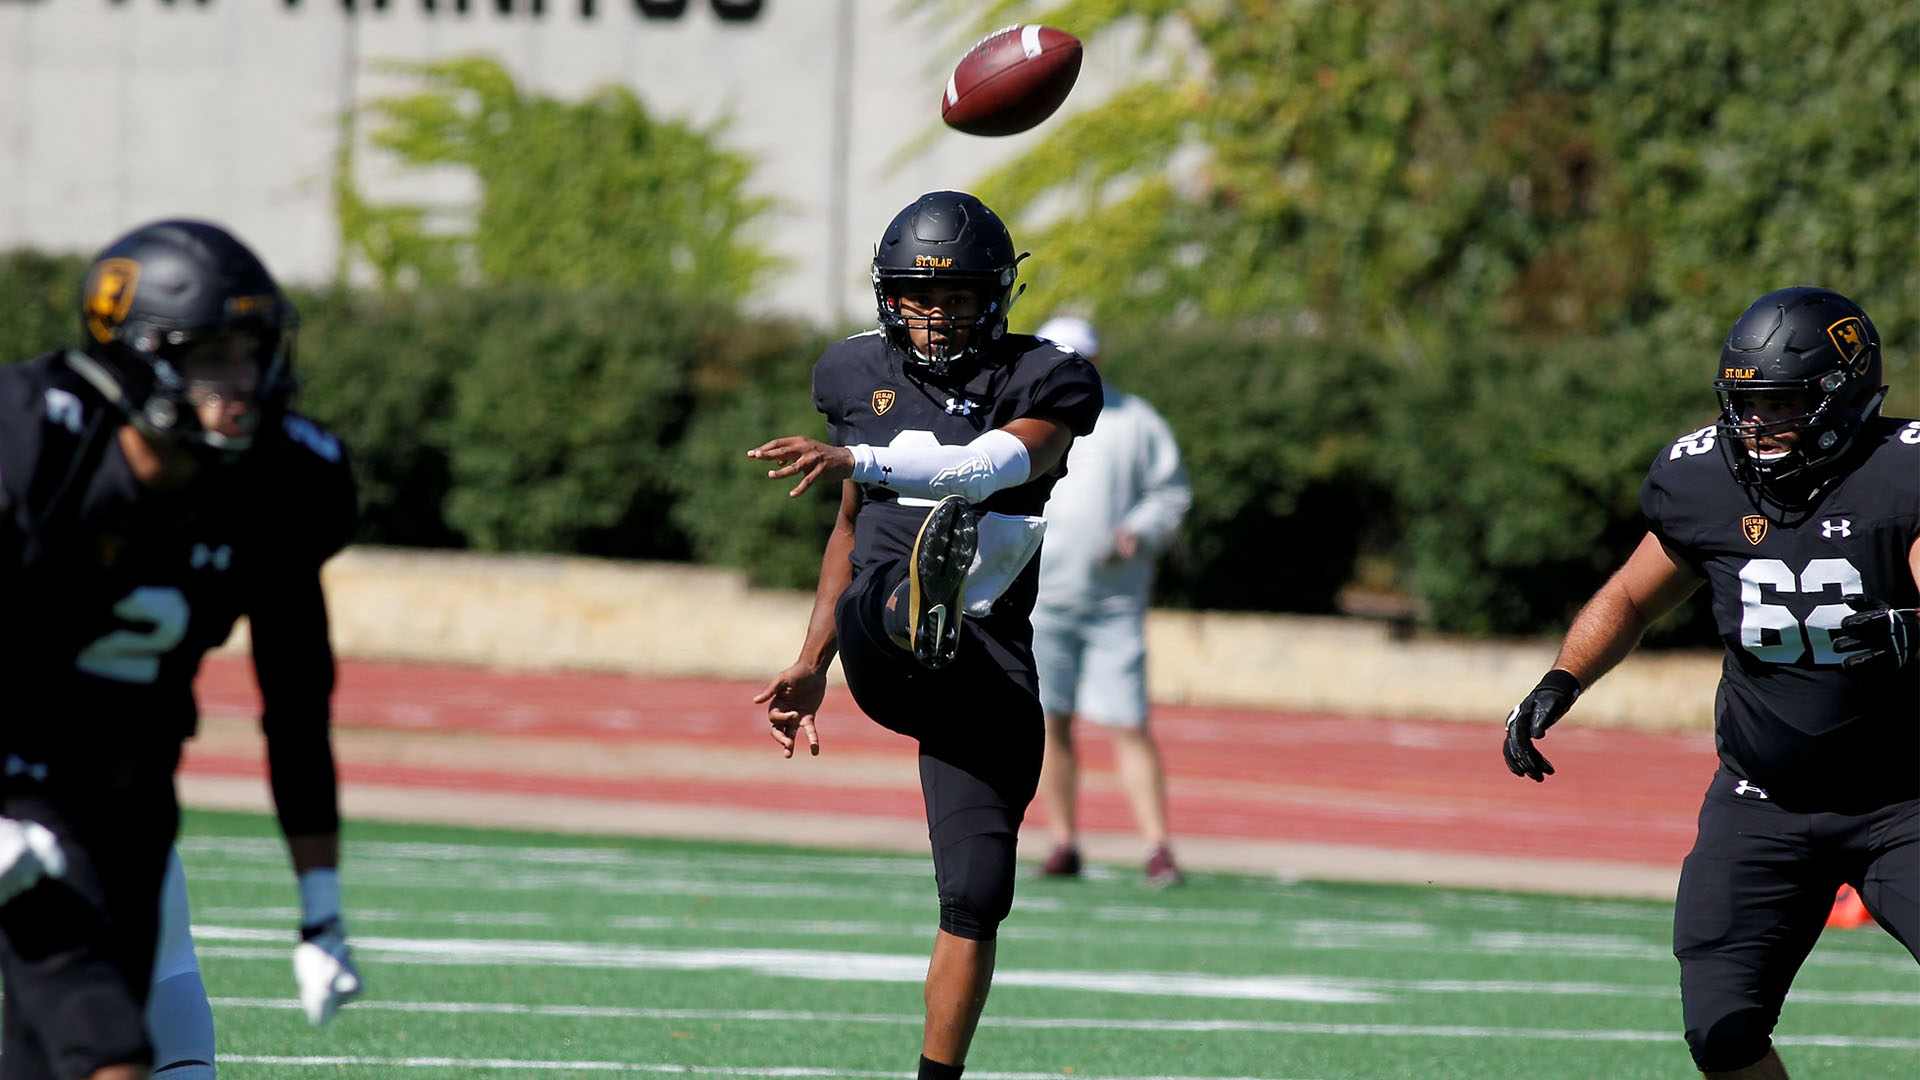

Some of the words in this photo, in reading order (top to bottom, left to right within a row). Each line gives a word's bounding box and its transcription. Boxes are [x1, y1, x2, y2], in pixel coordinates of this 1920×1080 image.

[915, 257, 929, 267] ST.
[929, 257, 953, 268] OLAF
[1725, 368, 1735, 379] ST.
[1735, 368, 1756, 379] OLAF
[75, 585, 191, 684] 2
[1738, 557, 1872, 665] 62
